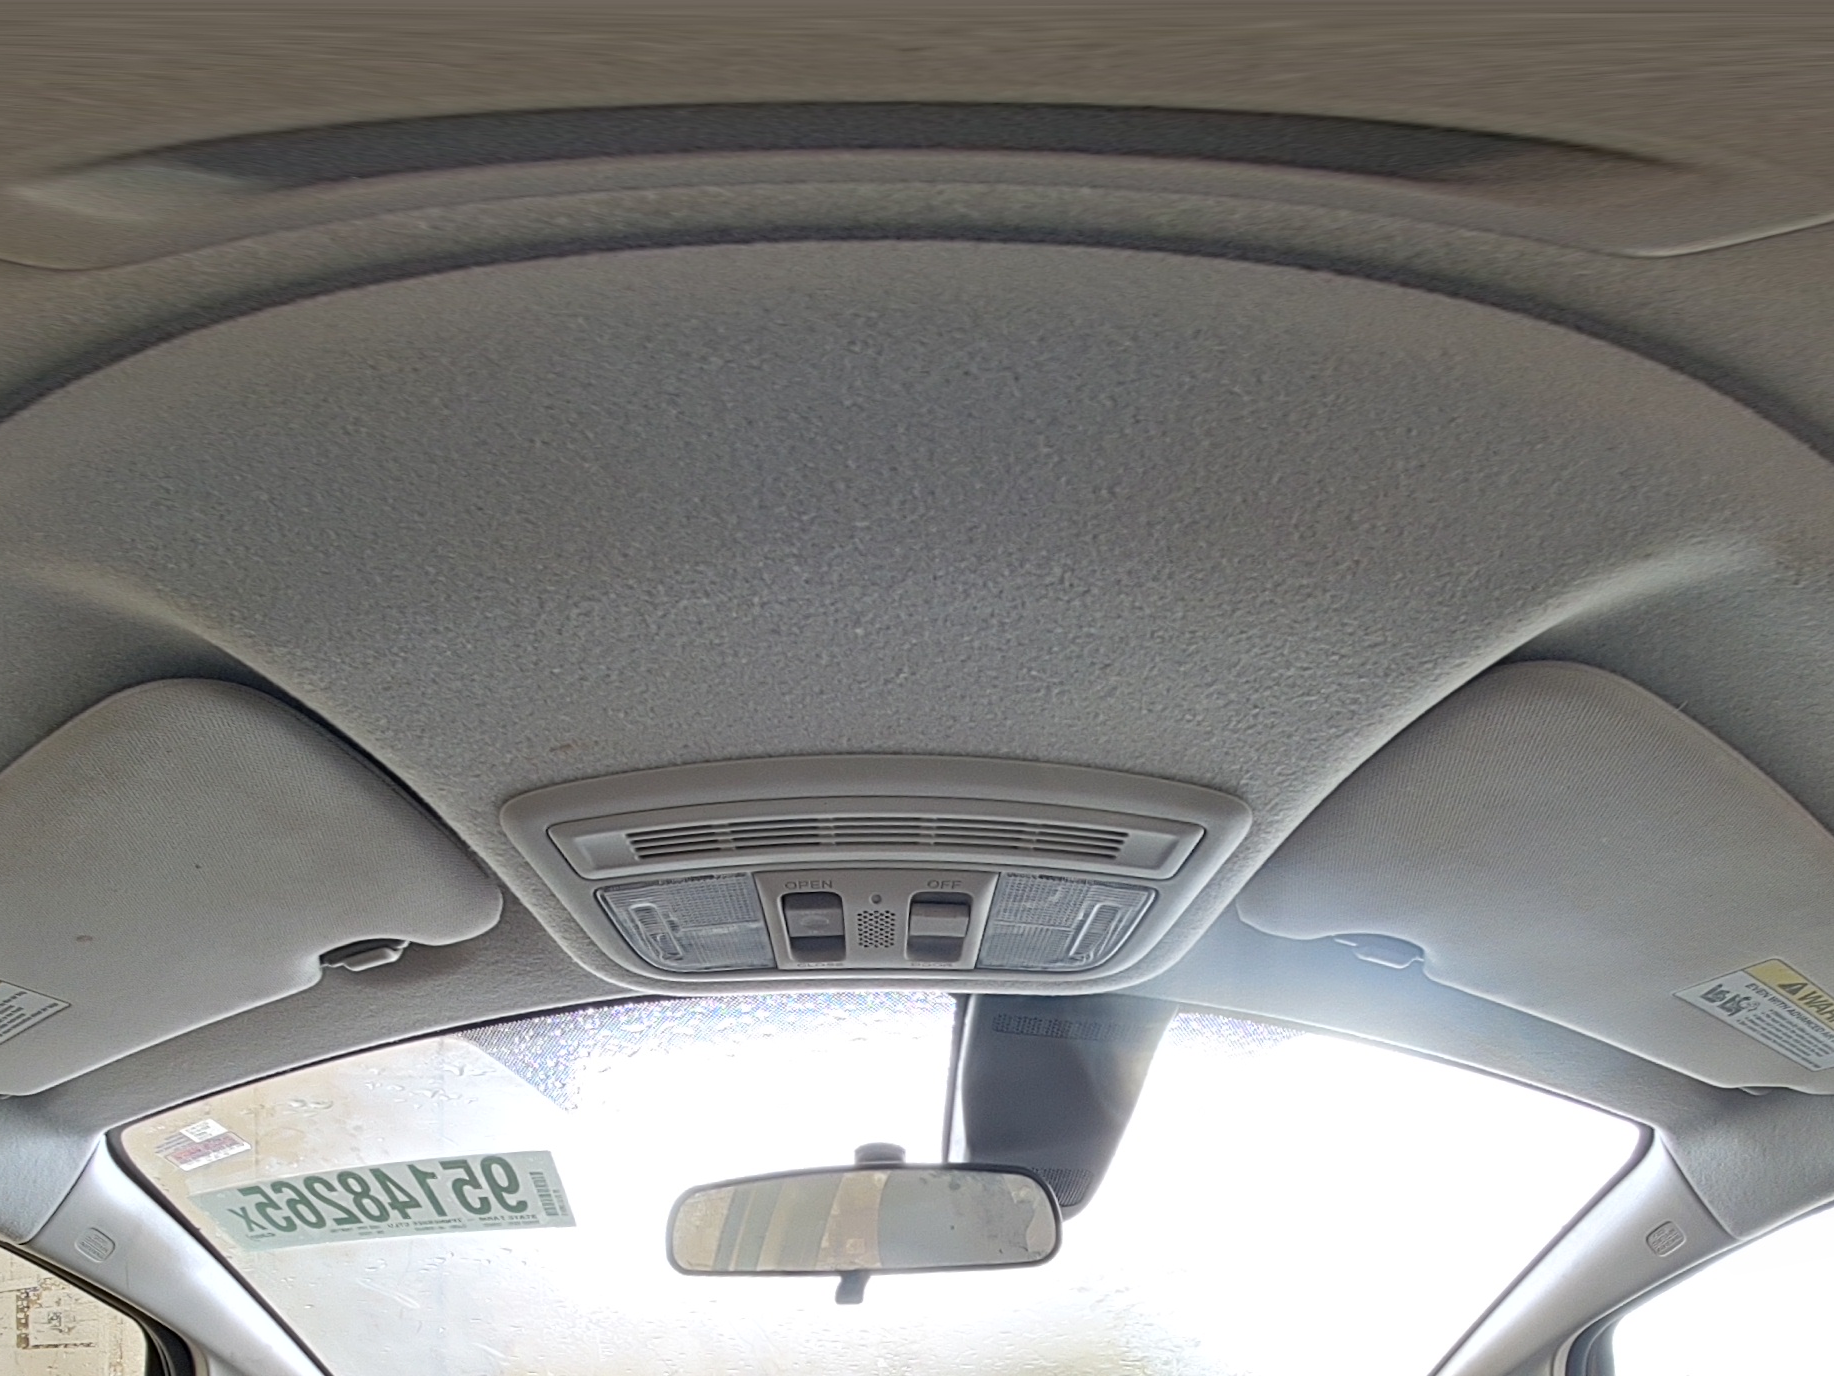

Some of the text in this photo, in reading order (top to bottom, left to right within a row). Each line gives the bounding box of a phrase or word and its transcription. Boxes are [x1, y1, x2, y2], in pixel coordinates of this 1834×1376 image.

[784, 880, 833, 890] OPEN
[927, 879, 962, 890] OFF
[1745, 983, 1771, 998] EVEN
[1768, 995, 1791, 1011] WITH
[1785, 1006, 1825, 1033] ADVANCED
